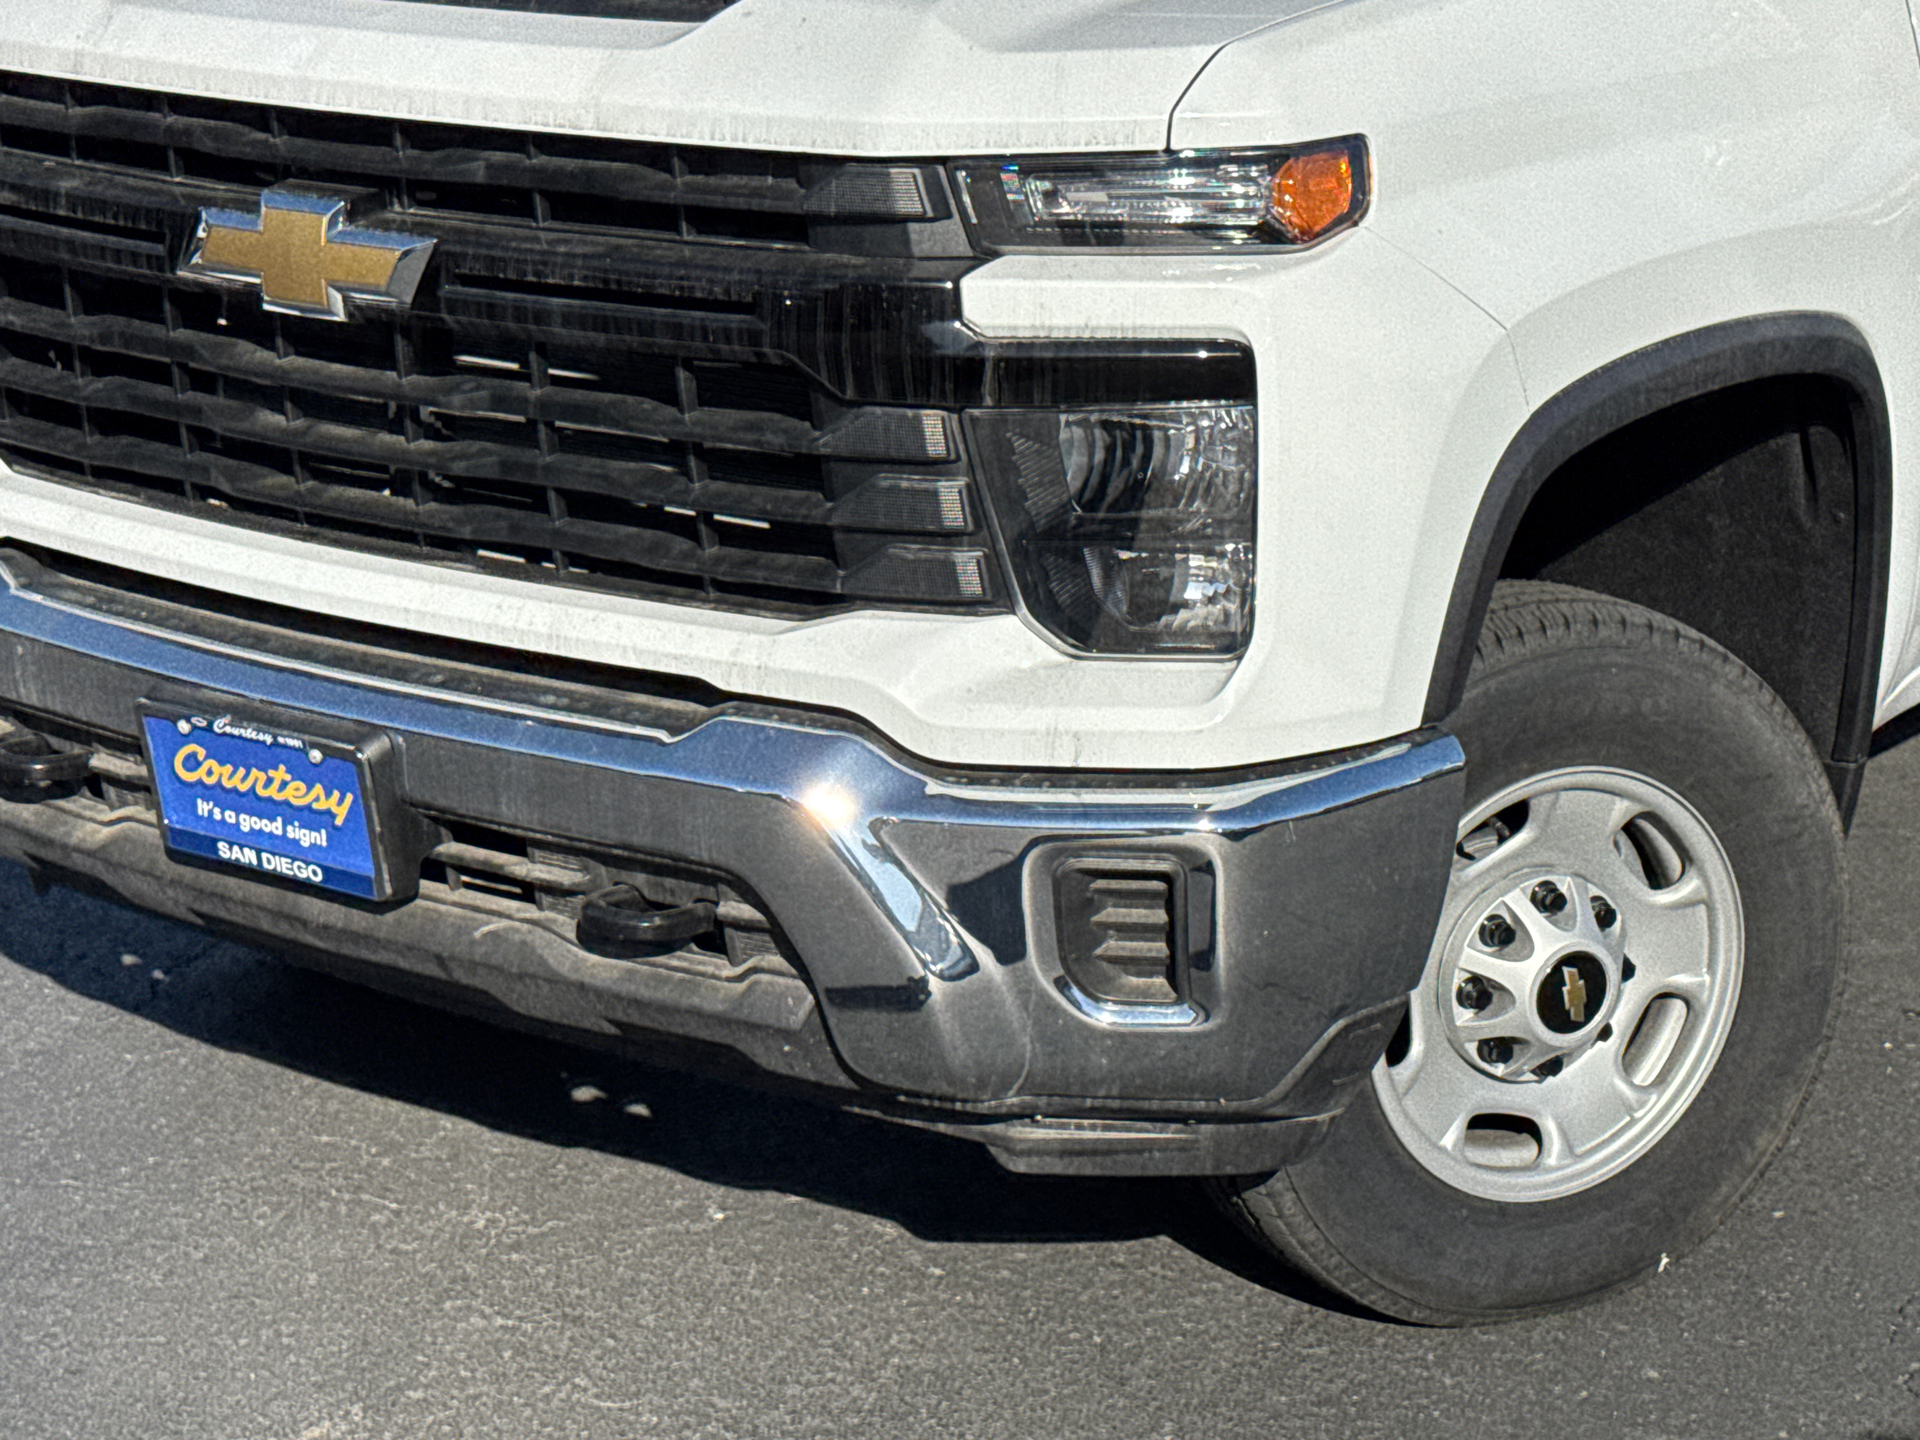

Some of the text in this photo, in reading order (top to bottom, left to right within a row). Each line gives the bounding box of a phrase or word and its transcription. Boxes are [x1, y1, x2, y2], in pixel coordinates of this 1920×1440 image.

[213, 717, 274, 746] Courtesy
[174, 743, 354, 826] Courtesy
[197, 798, 328, 848] It's a good sign!
[217, 841, 323, 883] SAN DIEGO
